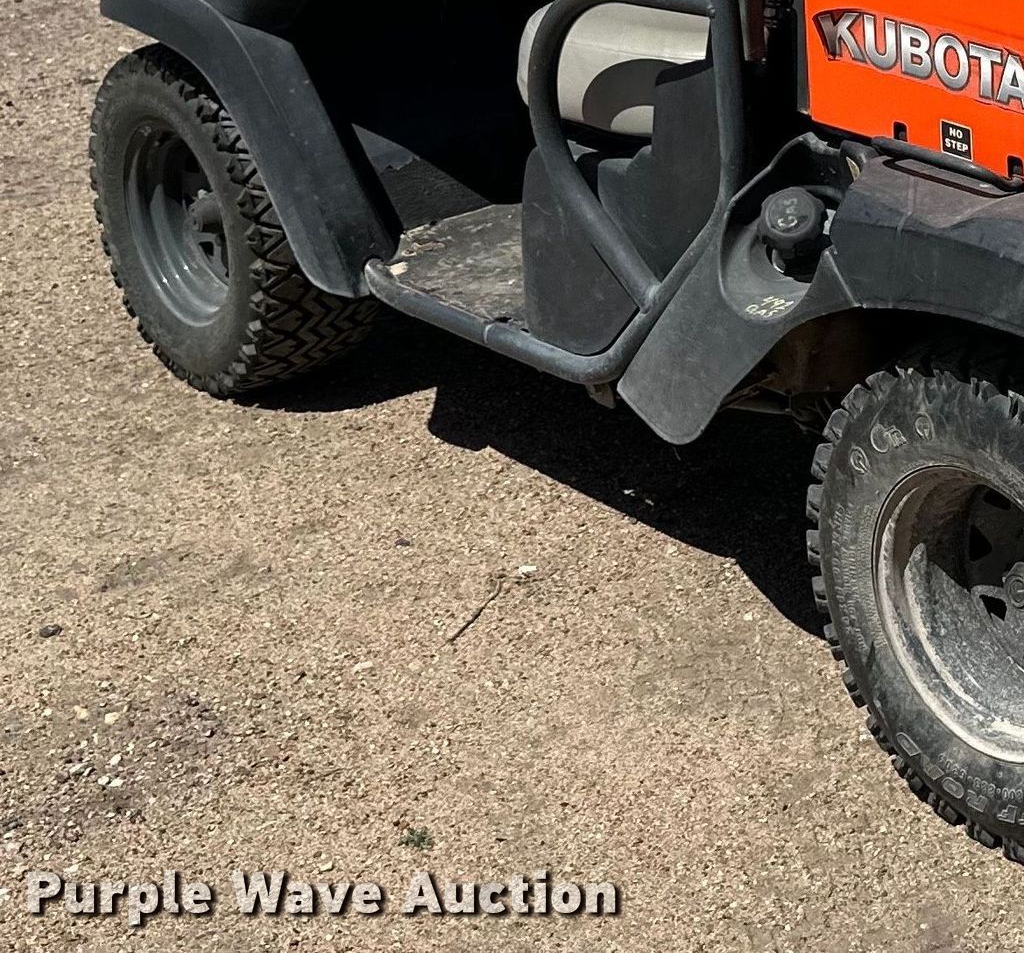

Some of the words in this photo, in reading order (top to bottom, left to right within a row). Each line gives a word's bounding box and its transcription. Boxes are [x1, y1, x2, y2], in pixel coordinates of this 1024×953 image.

[948, 126, 963, 139] NO
[944, 137, 970, 153] STEP
[895, 731, 989, 813] ROAD
